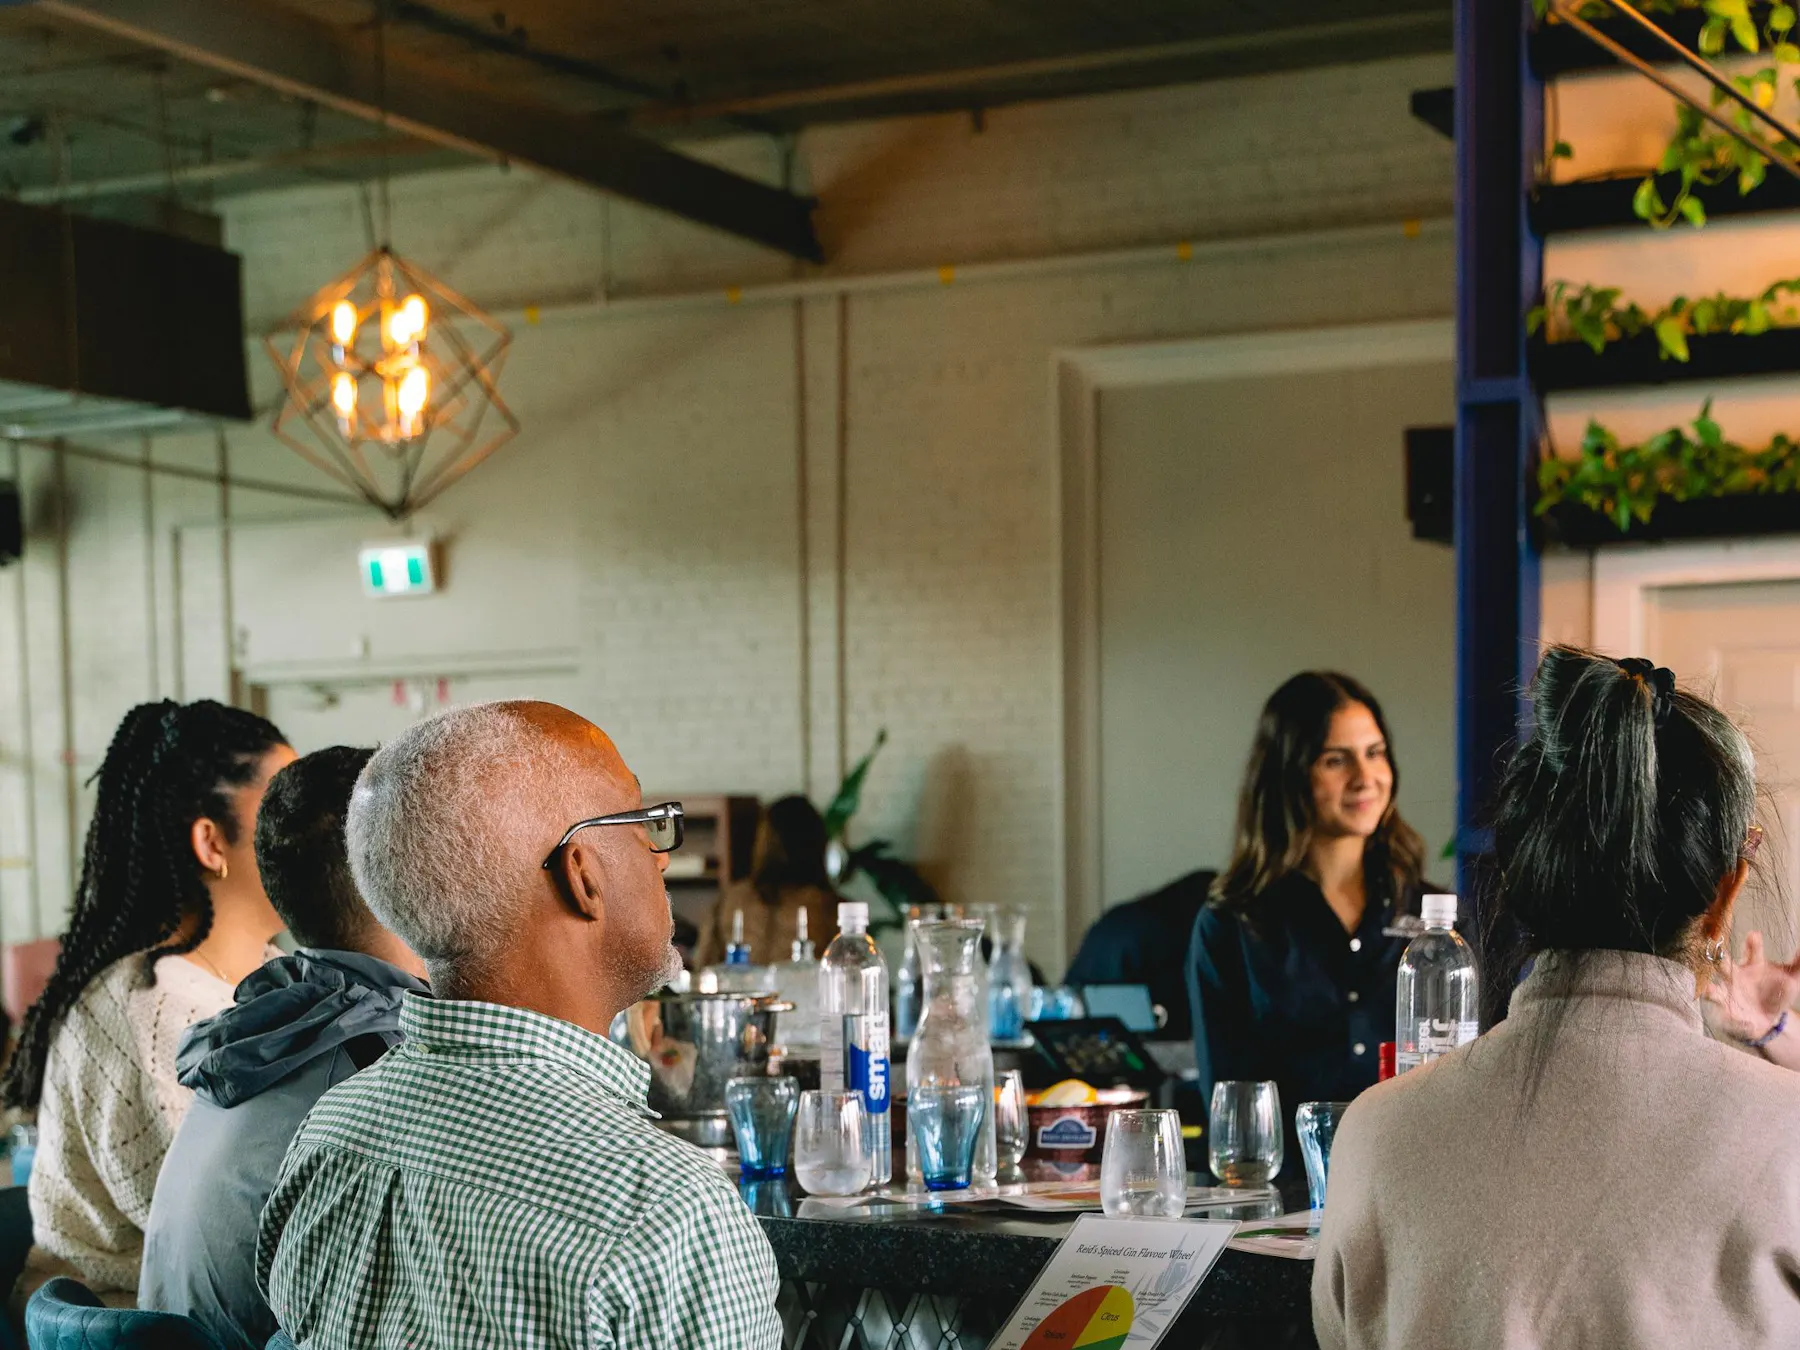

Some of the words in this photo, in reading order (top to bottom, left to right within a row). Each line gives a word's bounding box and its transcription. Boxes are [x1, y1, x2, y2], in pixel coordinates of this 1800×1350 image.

[868, 1011, 888, 1100] smart
[1076, 1243, 1099, 1254] Reid's
[1097, 1245, 1124, 1257] Spiced
[1123, 1247, 1137, 1257] Gin
[1137, 1248, 1167, 1259] Flavour
[1168, 1249, 1196, 1260] Wheel
[1101, 1312, 1120, 1321] Citrus
